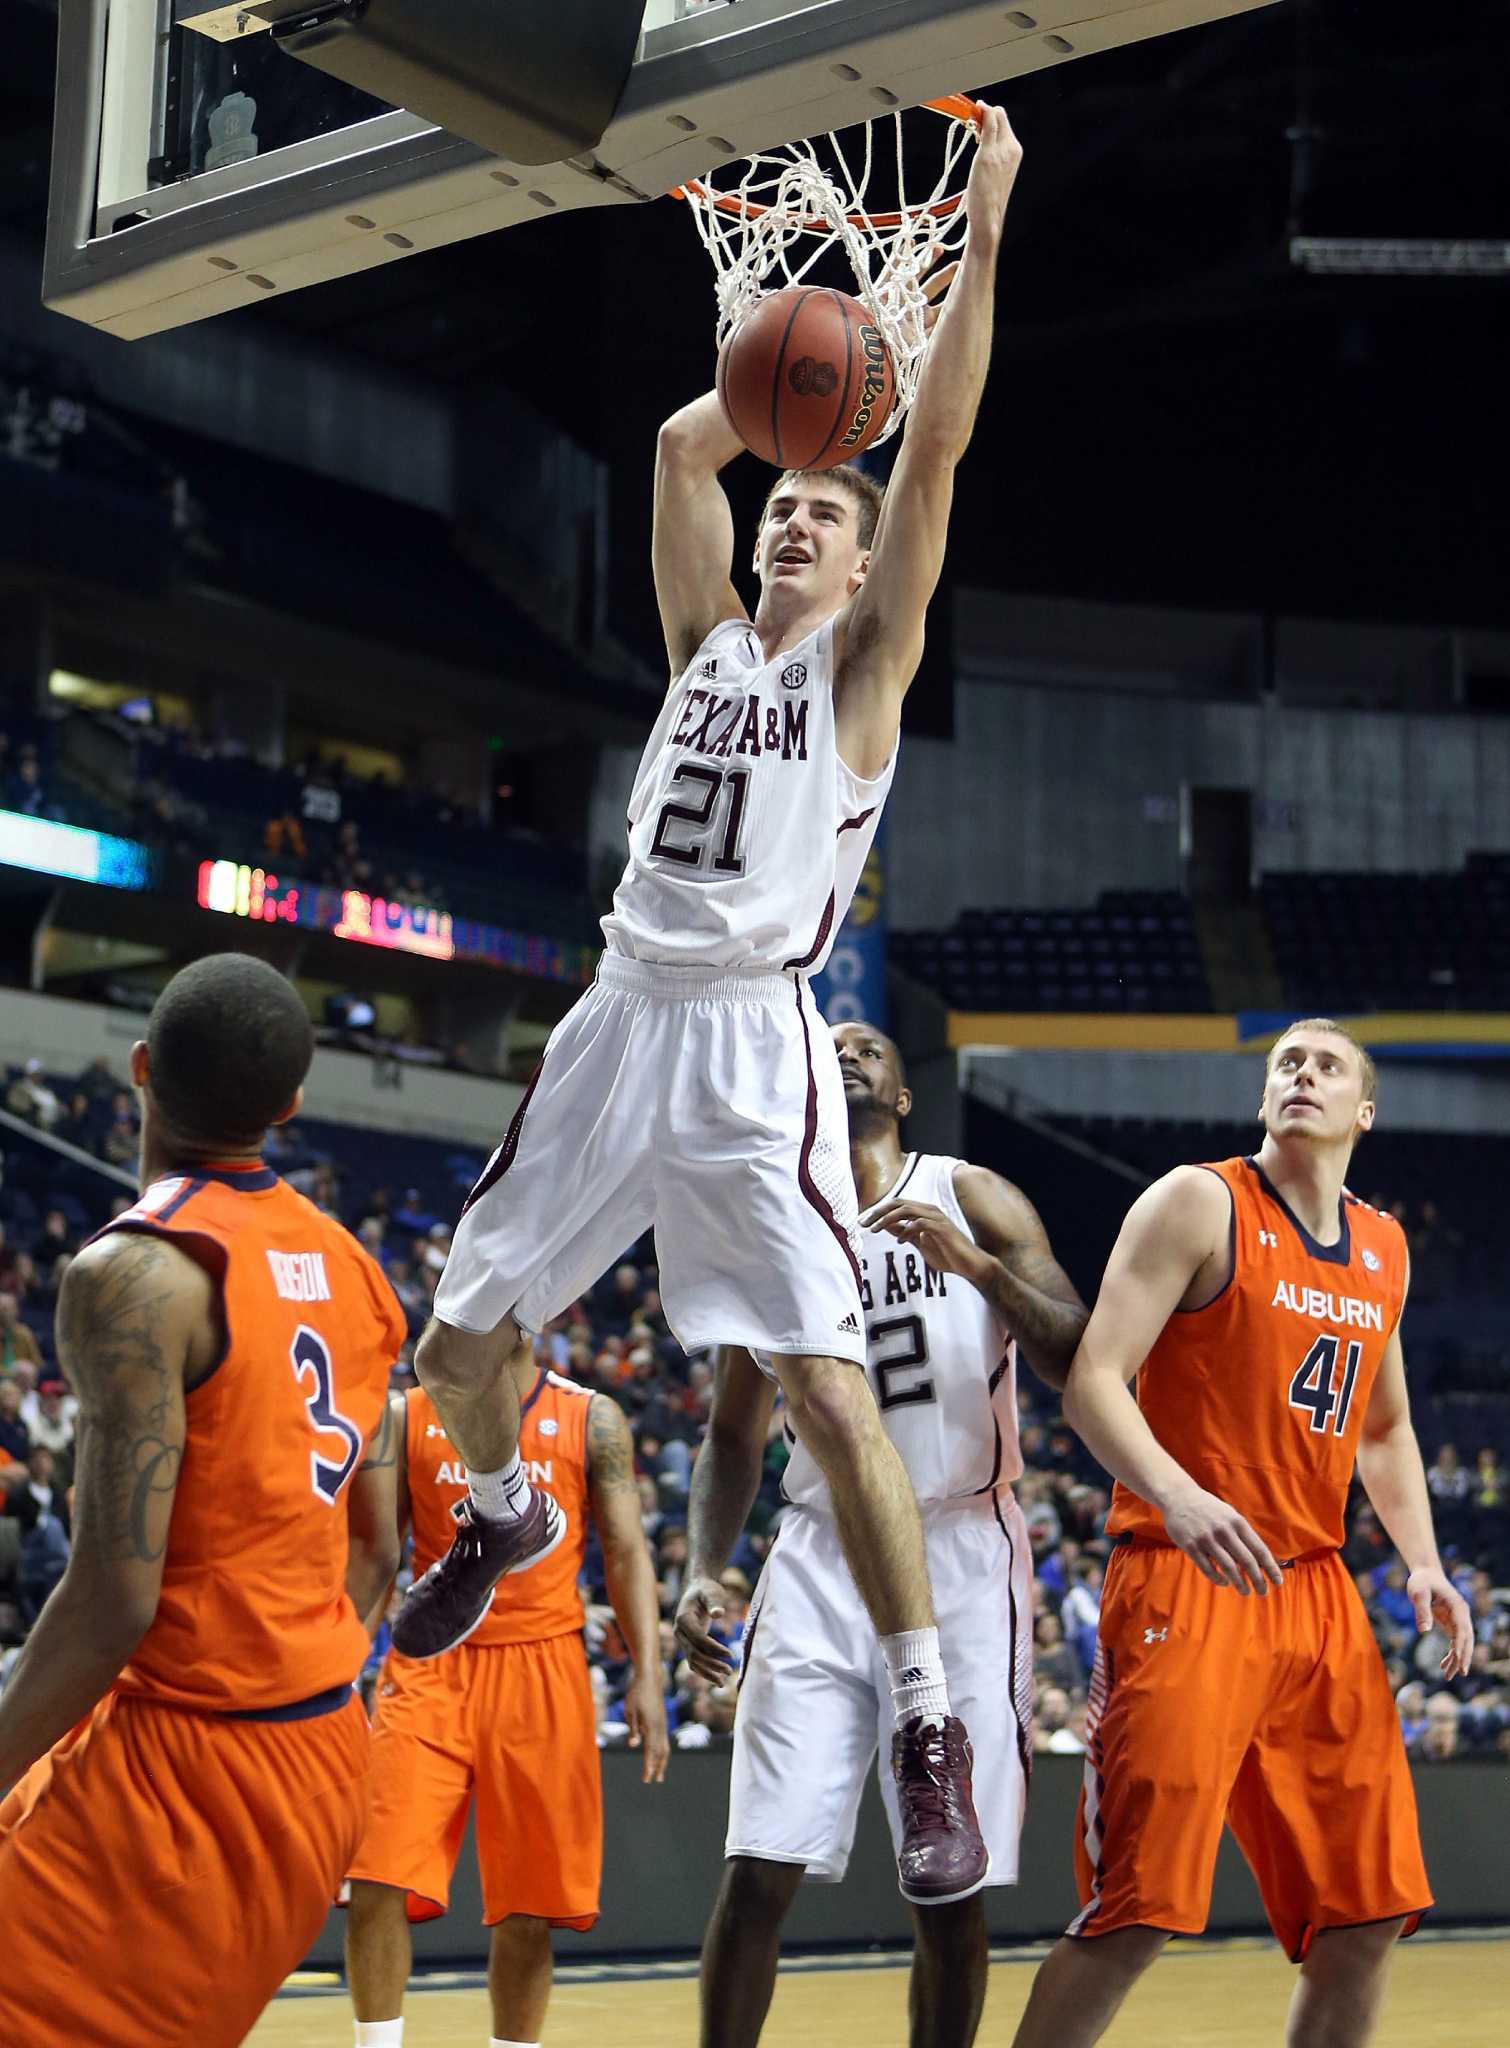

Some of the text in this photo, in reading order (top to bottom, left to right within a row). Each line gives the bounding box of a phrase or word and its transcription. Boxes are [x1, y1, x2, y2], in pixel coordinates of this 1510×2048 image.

[838, 325, 886, 447] Wilson
[782, 665, 807, 688] SEC
[736, 694, 809, 761] A&M
[648, 760, 752, 874] 21
[885, 1251, 947, 1306] A&M
[1272, 1280, 1383, 1332] AUBURN
[290, 1324, 362, 1506] 3
[1288, 1333, 1364, 1437] 41
[434, 1459, 553, 1487] AURN
